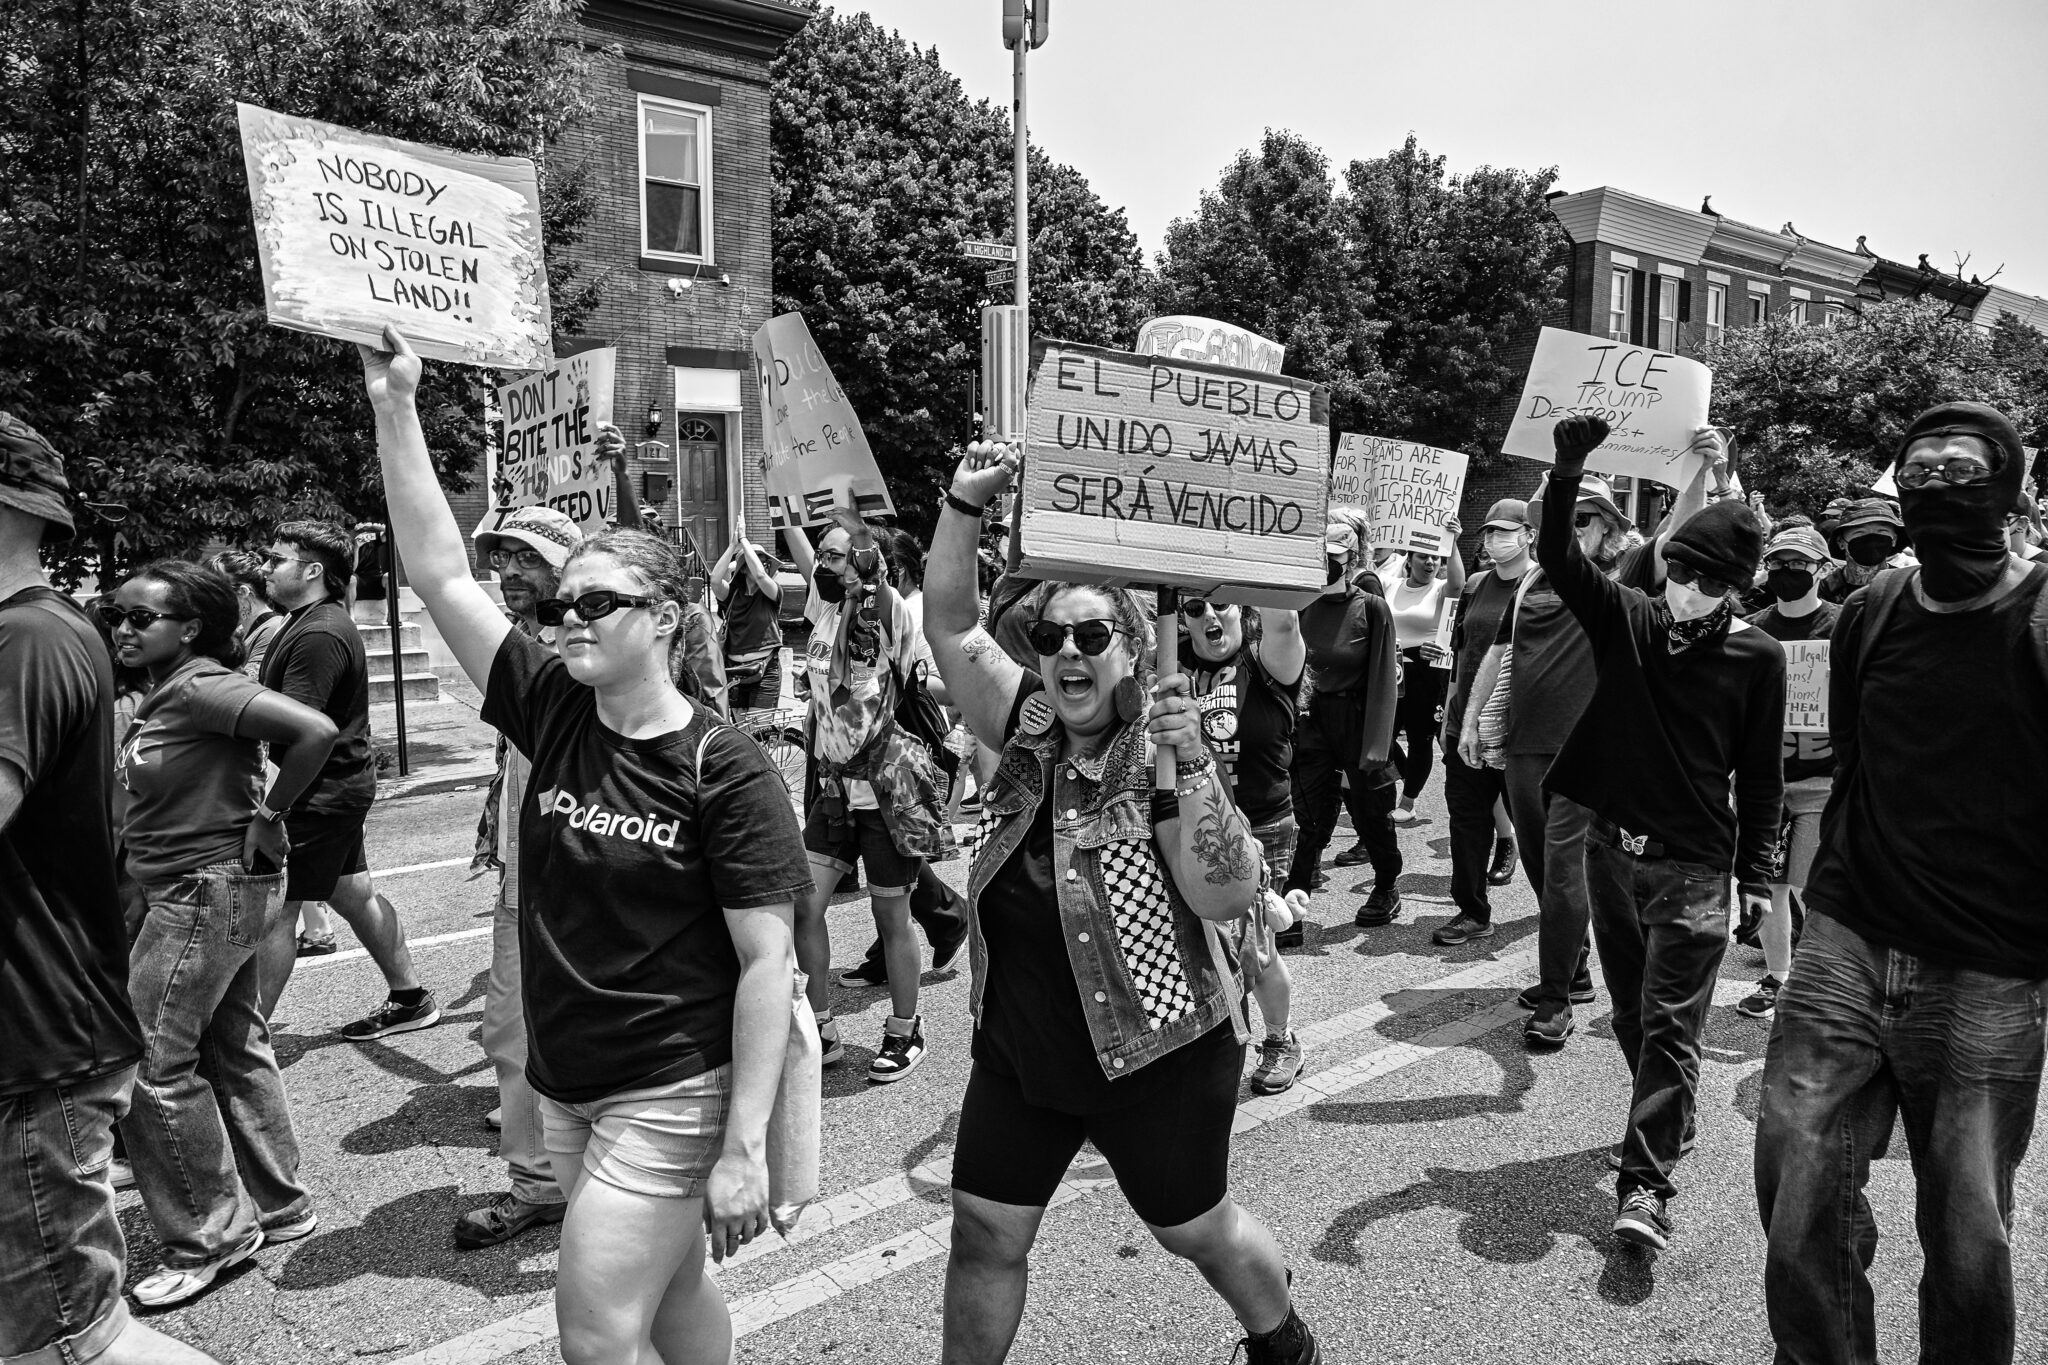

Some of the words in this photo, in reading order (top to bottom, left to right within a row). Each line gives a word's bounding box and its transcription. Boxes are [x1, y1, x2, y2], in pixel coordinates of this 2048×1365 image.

[316, 153, 448, 206] NOBODY
[312, 192, 348, 225] IS
[358, 198, 489, 249] ILLEGAL
[329, 232, 368, 260] ON
[374, 239, 479, 284] STOLEN
[973, 245, 1005, 258] HIGHLAND
[986, 271, 1007, 284] ESTHER
[367, 273, 473, 324] LAND!!
[1582, 345, 1675, 391] ICE
[507, 369, 561, 425] DON'T
[1057, 355, 1121, 398] EL
[1150, 365, 1301, 421] PUEBLO
[1576, 384, 1663, 409] TRUMP
[504, 420, 548, 466] BITE
[551, 405, 592, 450] THE
[790, 435, 818, 459] the
[1057, 414, 1173, 458] UNIDO
[1189, 427, 1299, 476] JAMAS
[1339, 434, 1356, 451] WE
[1334, 455, 1357, 473] FOR
[1408, 445, 1445, 465] ARE
[1596, 440, 1692, 466] ommunities!
[1331, 474, 1360, 495] WHO
[1379, 464, 1461, 497] ILLEGAL!
[596, 485, 611, 519] U
[1051, 464, 1155, 521] SERÁ
[1163, 480, 1303, 537] VENCIDO
[1370, 525, 1405, 545] EAT!!
[1786, 683, 1821, 703] tions!
[1788, 712, 1825, 728] LL!
[552, 788, 681, 848] Polaroid
